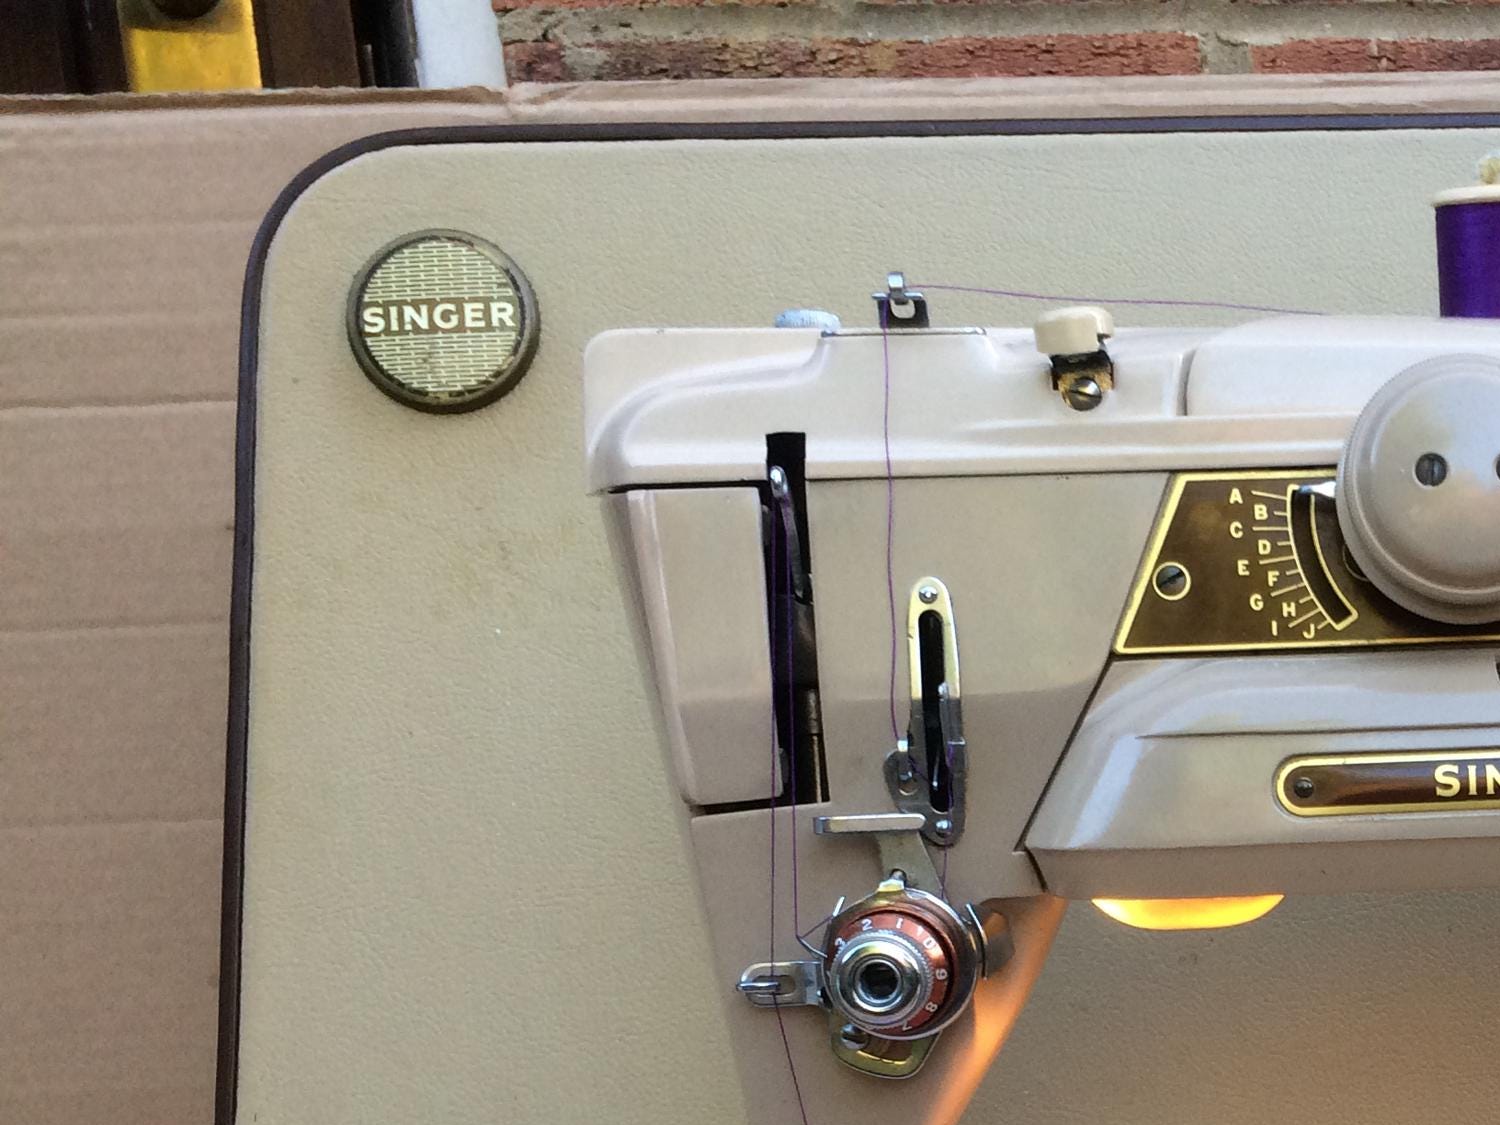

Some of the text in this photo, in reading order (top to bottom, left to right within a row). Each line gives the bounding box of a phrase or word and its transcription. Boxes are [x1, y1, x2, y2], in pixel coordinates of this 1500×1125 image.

[363, 302, 516, 333] SINGER
[1229, 488, 1243, 504] A
[1254, 504, 1268, 520] B
[1230, 522, 1243, 538] C
[1258, 540, 1271, 555] D
[1237, 560, 1250, 576] E
[1268, 571, 1280, 587] F
[1249, 594, 1264, 611] G
[1282, 602, 1296, 617] H
[1271, 620, 1279, 636] I
[1303, 623, 1315, 639] J
[861, 918, 872, 931] 2
